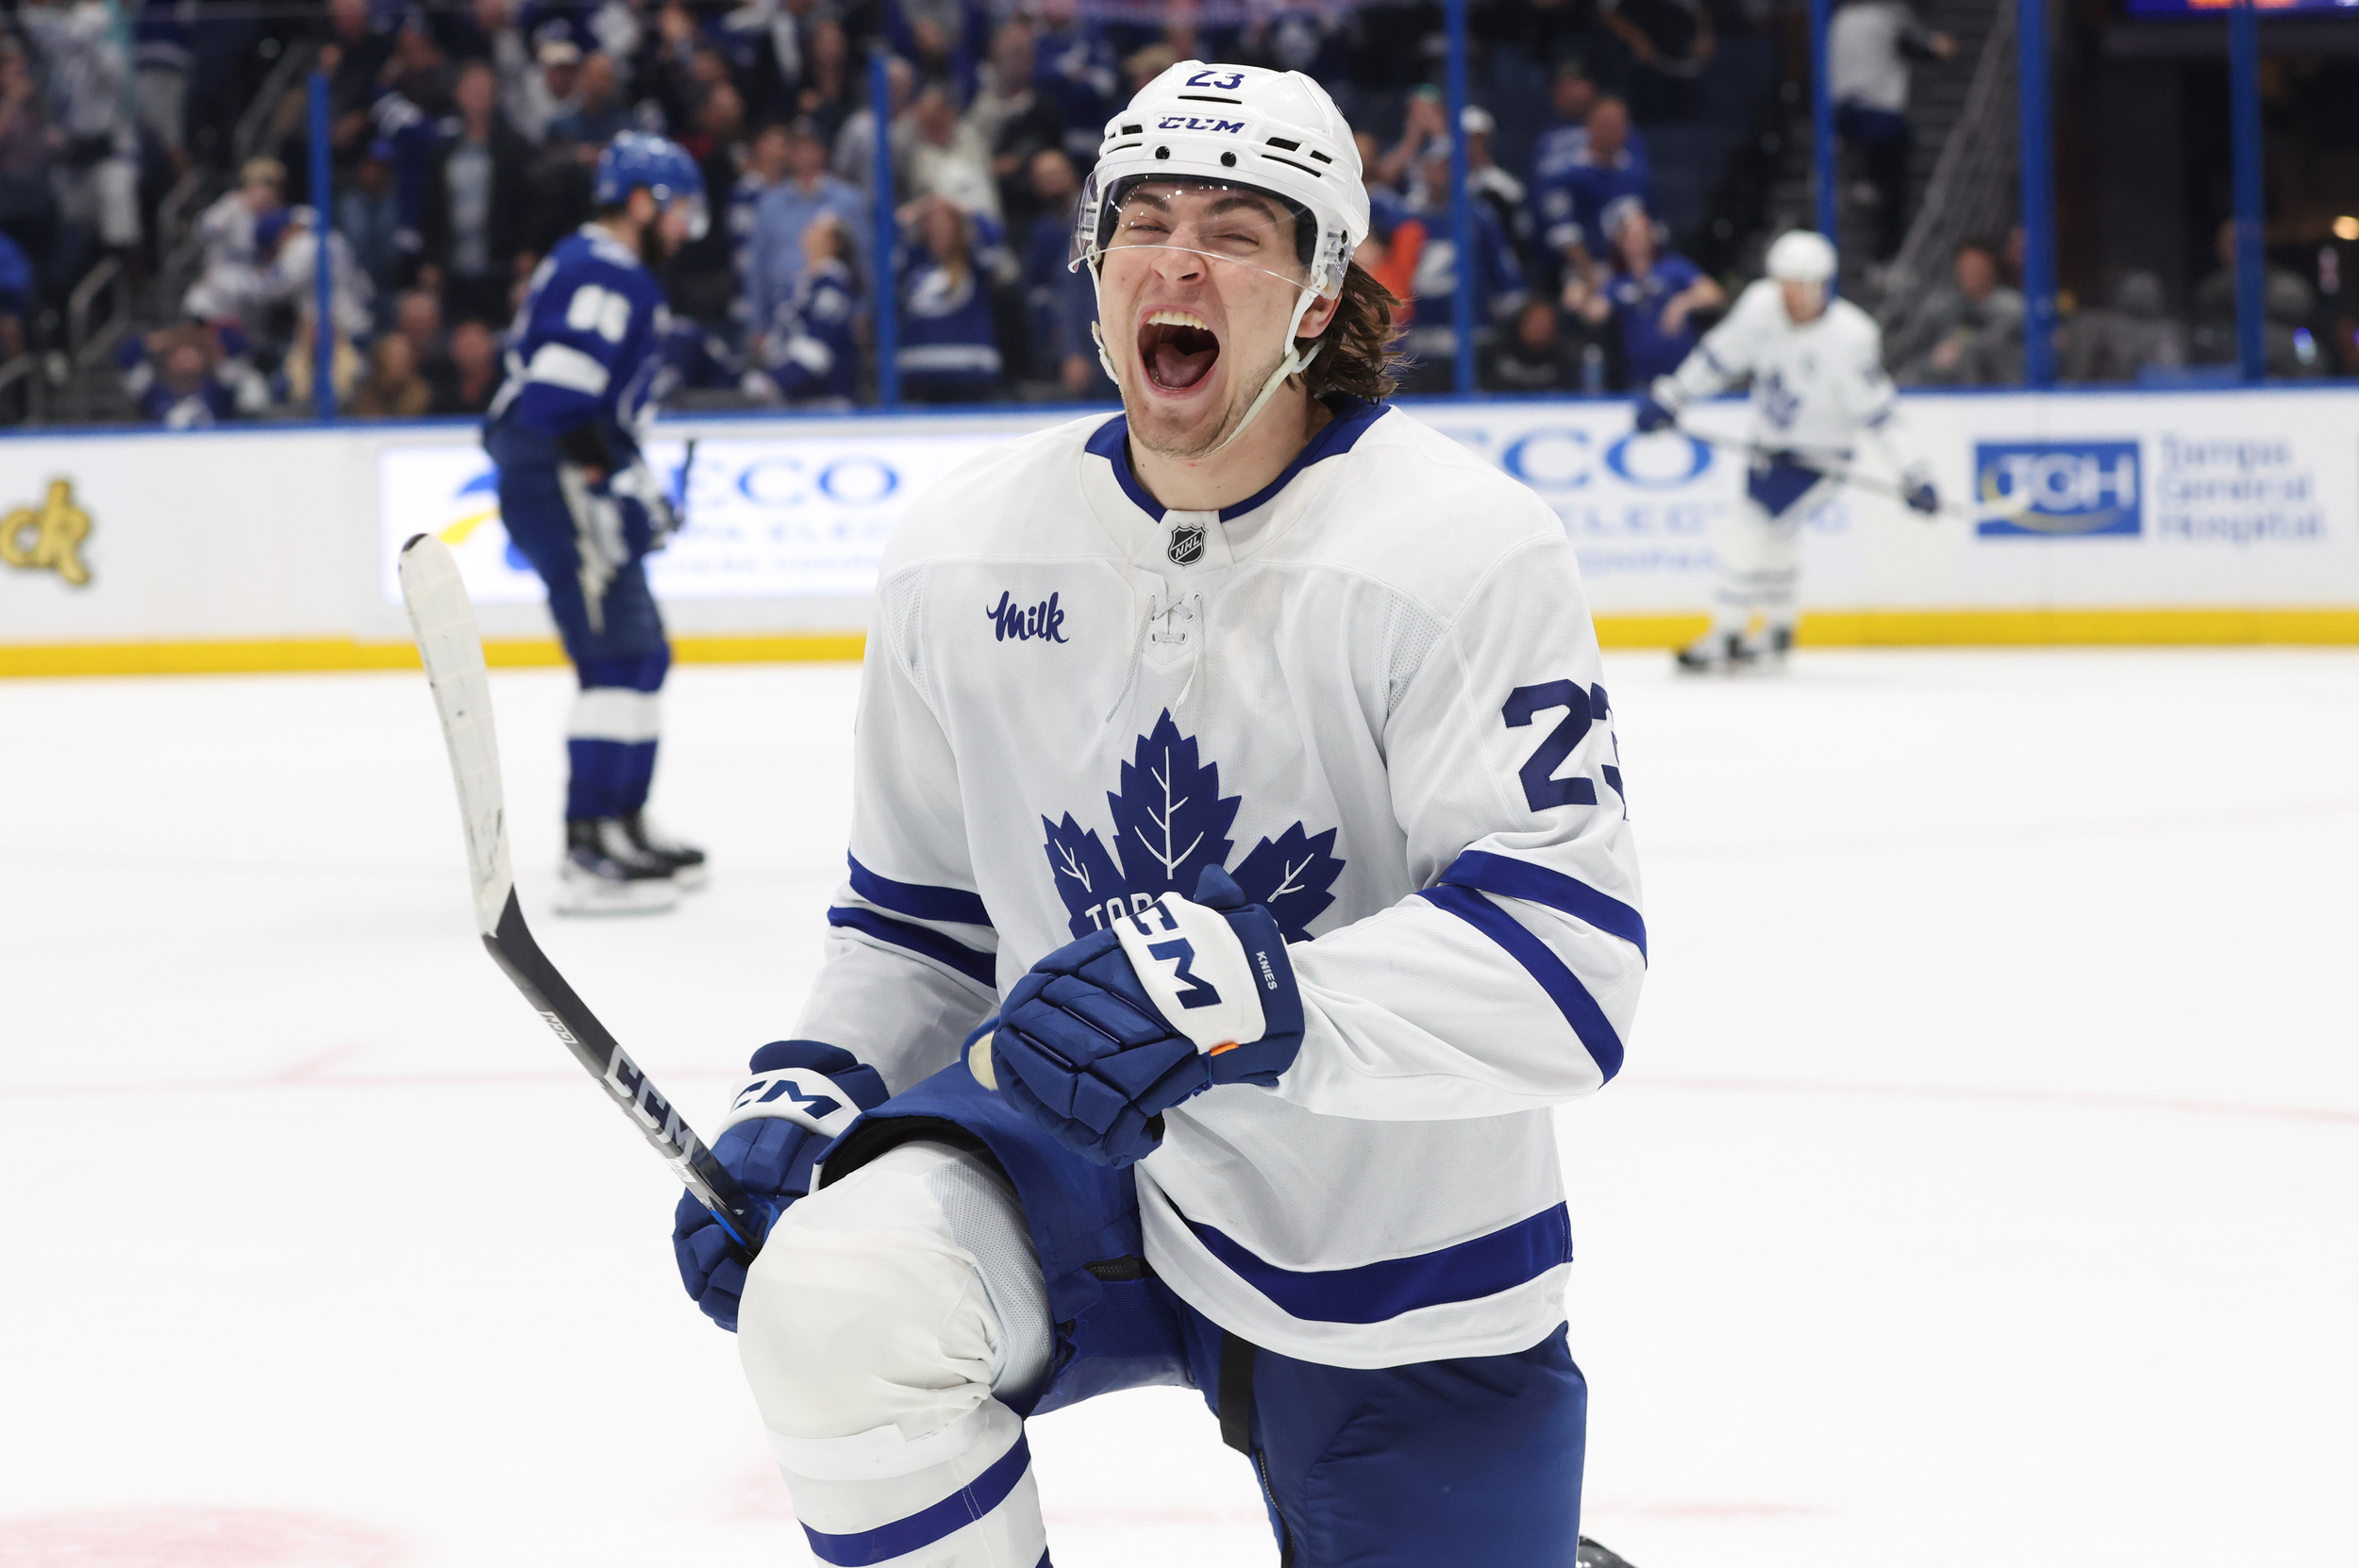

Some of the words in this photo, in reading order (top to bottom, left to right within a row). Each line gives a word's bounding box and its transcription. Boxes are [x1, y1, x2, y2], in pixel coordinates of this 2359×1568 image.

[1157, 116, 1246, 134] CCM
[1175, 535, 1200, 559] NHL
[986, 590, 1070, 643] Milk
[1129, 899, 1223, 1010] CM
[1255, 950, 1278, 991] KNIES
[603, 1043, 697, 1166] CCM
[729, 1078, 843, 1121] CM
